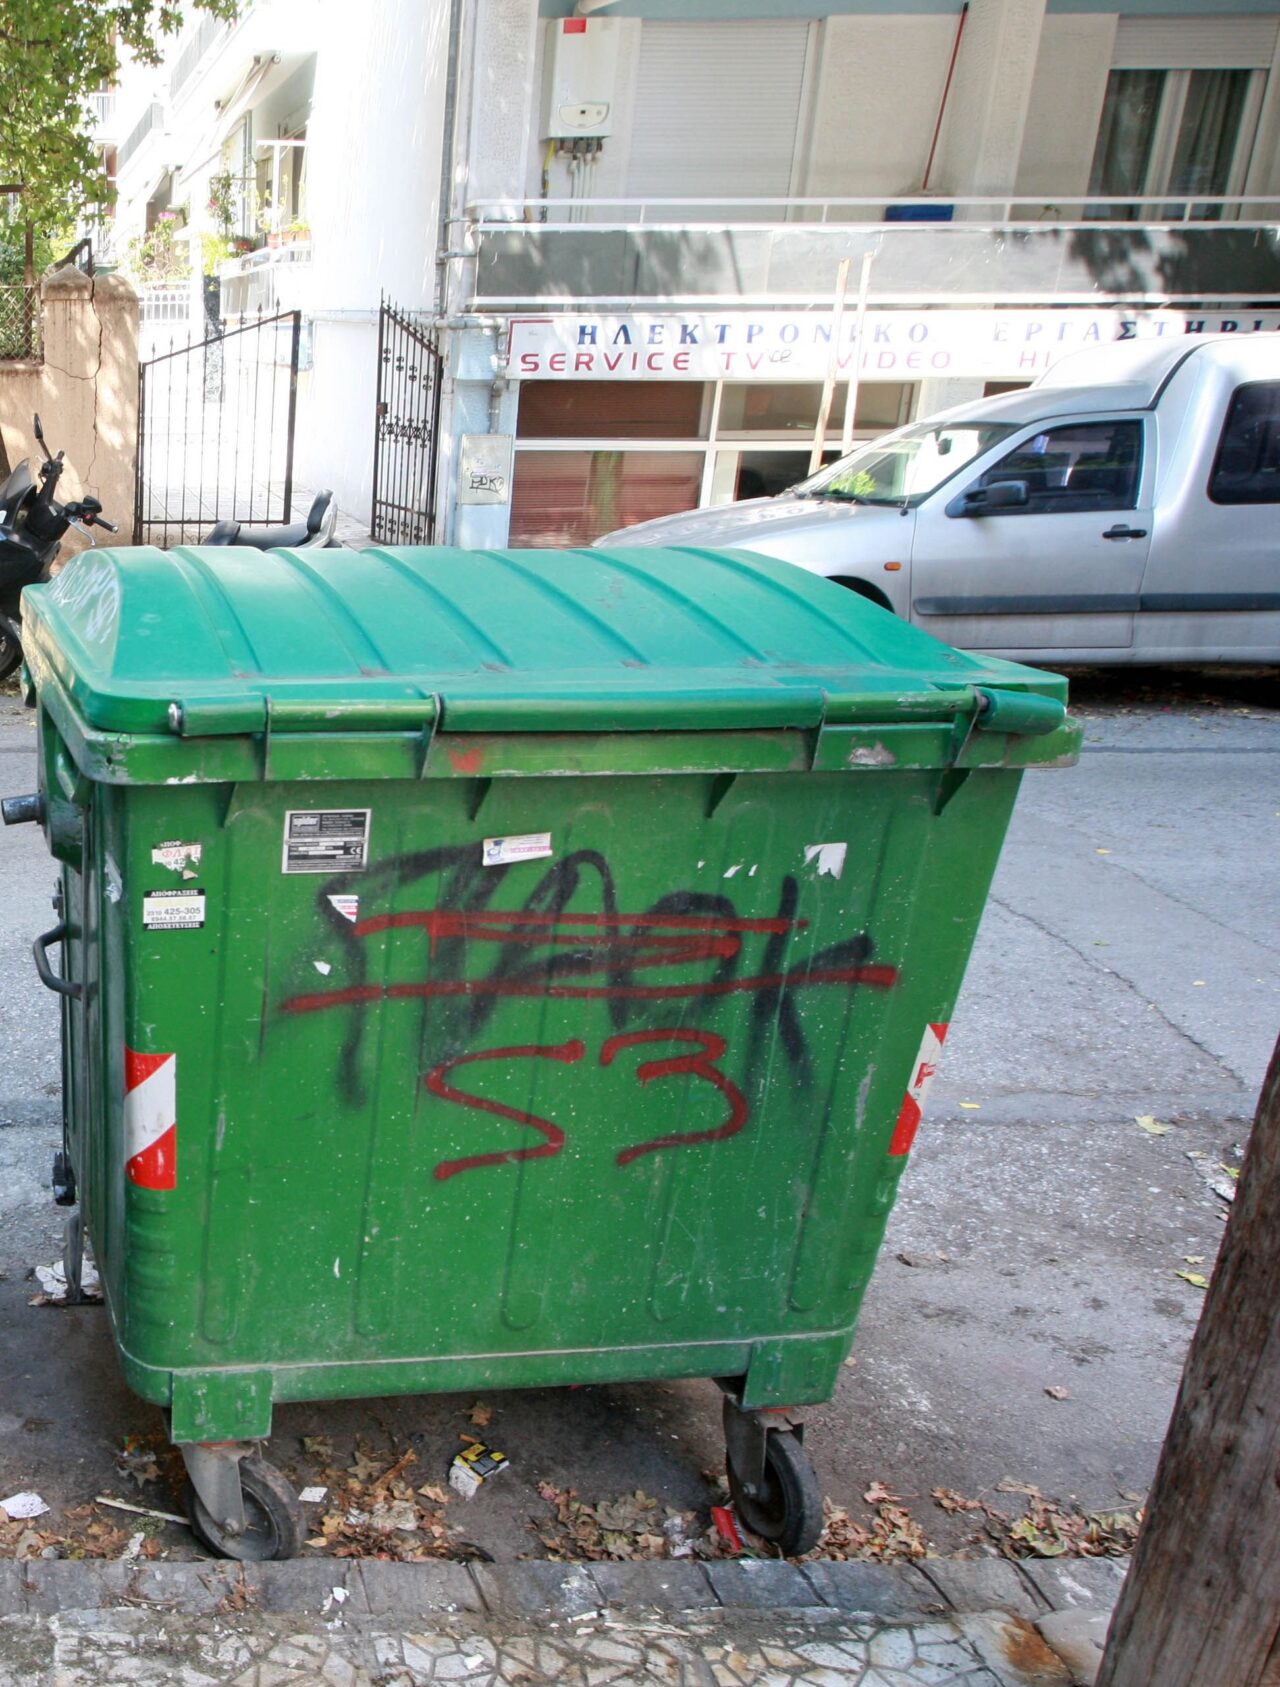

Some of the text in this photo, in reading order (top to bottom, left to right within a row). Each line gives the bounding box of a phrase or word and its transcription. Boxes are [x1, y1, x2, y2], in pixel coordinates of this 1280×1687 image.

[521, 352, 690, 372] SERVICE
[721, 351, 764, 371] TV
[836, 350, 952, 369] VIDEO
[163, 907, 201, 915] 425-305
